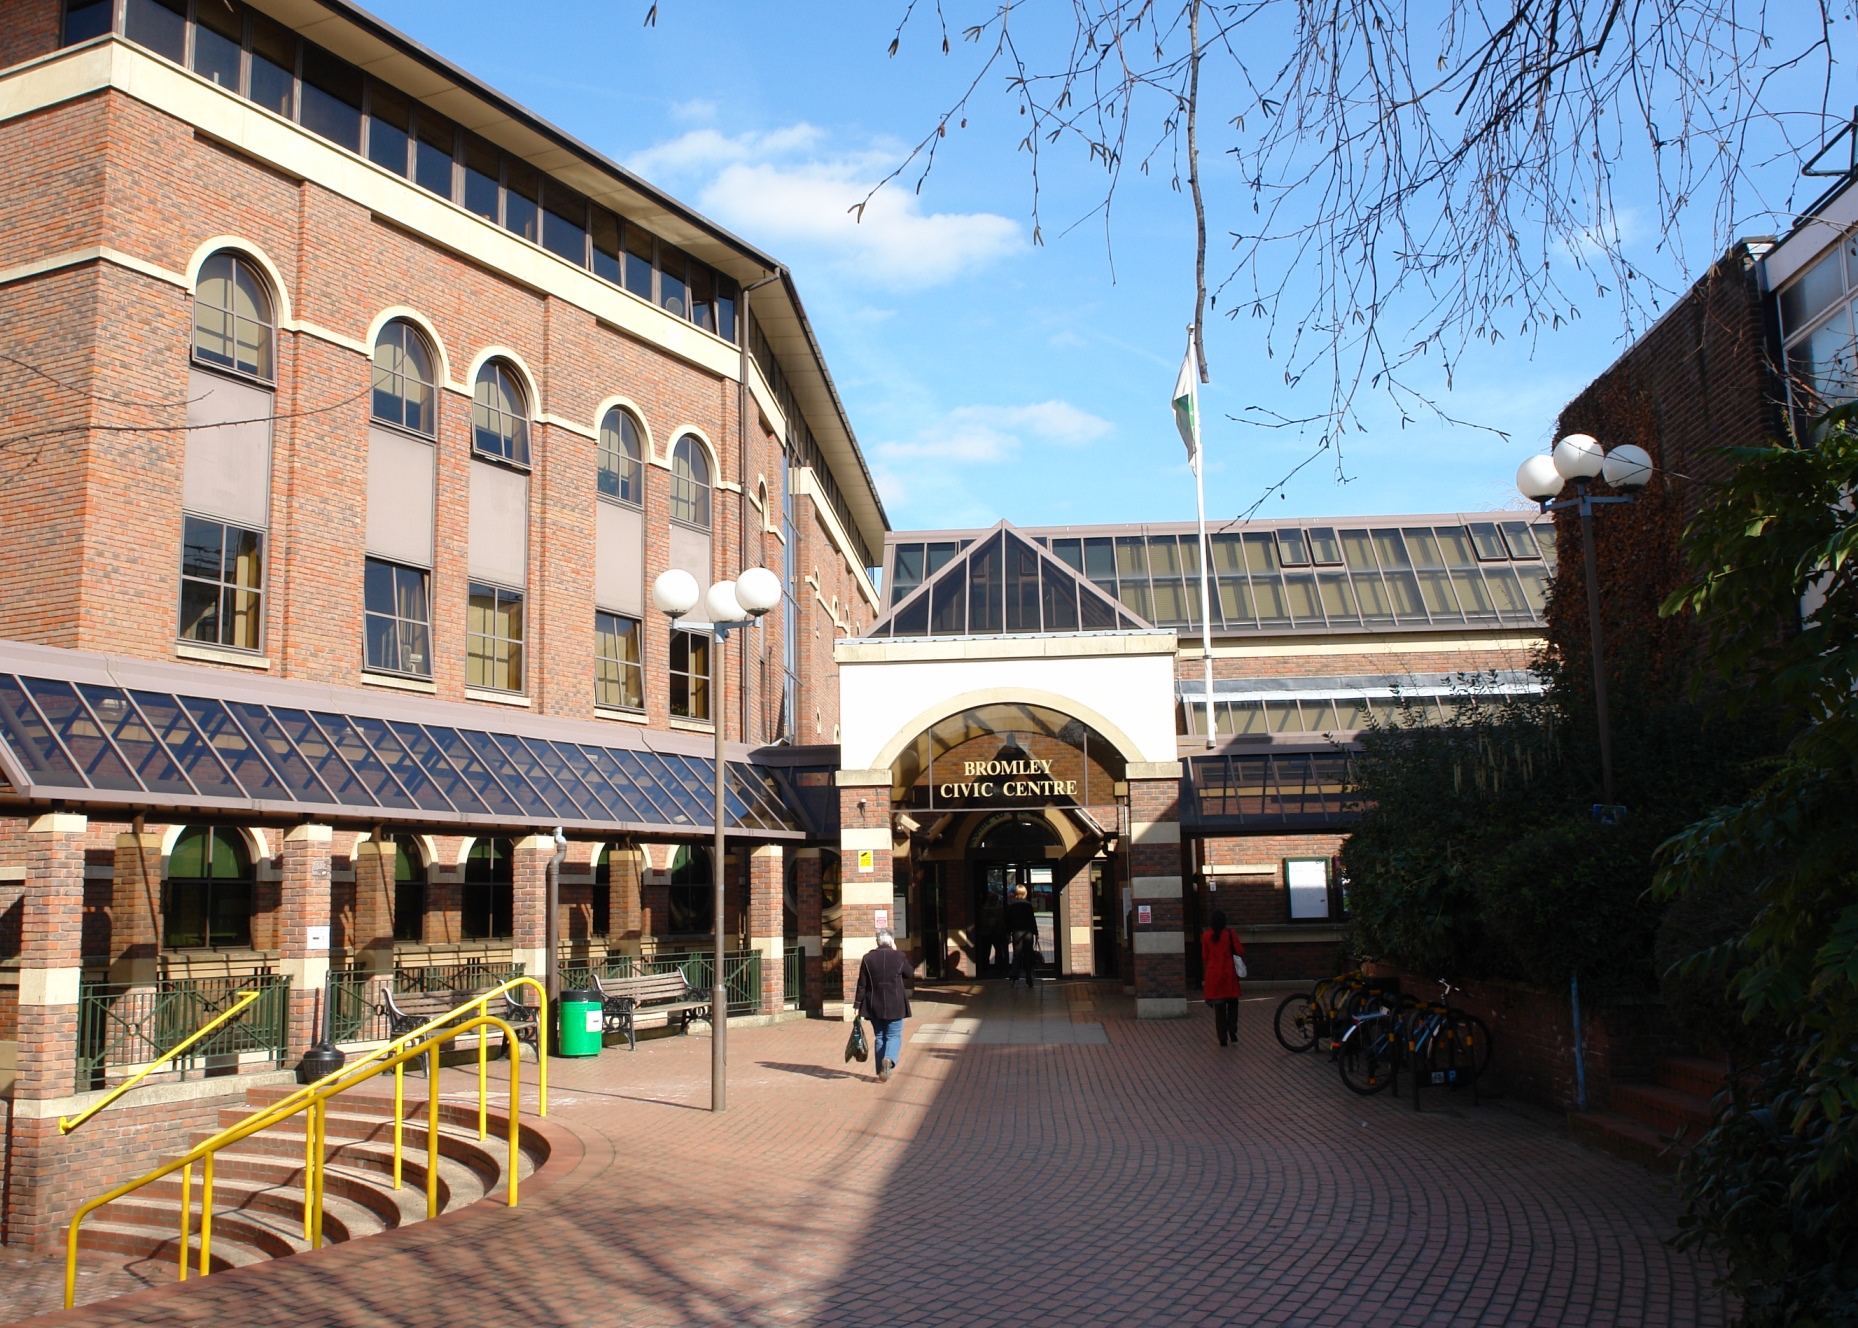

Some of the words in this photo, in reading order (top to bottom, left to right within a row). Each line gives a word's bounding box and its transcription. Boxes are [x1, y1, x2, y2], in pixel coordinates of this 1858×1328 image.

[964, 759, 1053, 776] BROMLEY
[940, 782, 994, 798] CIVIC
[1003, 780, 1077, 797] CENTRE
[1449, 1069, 1456, 1082] P
